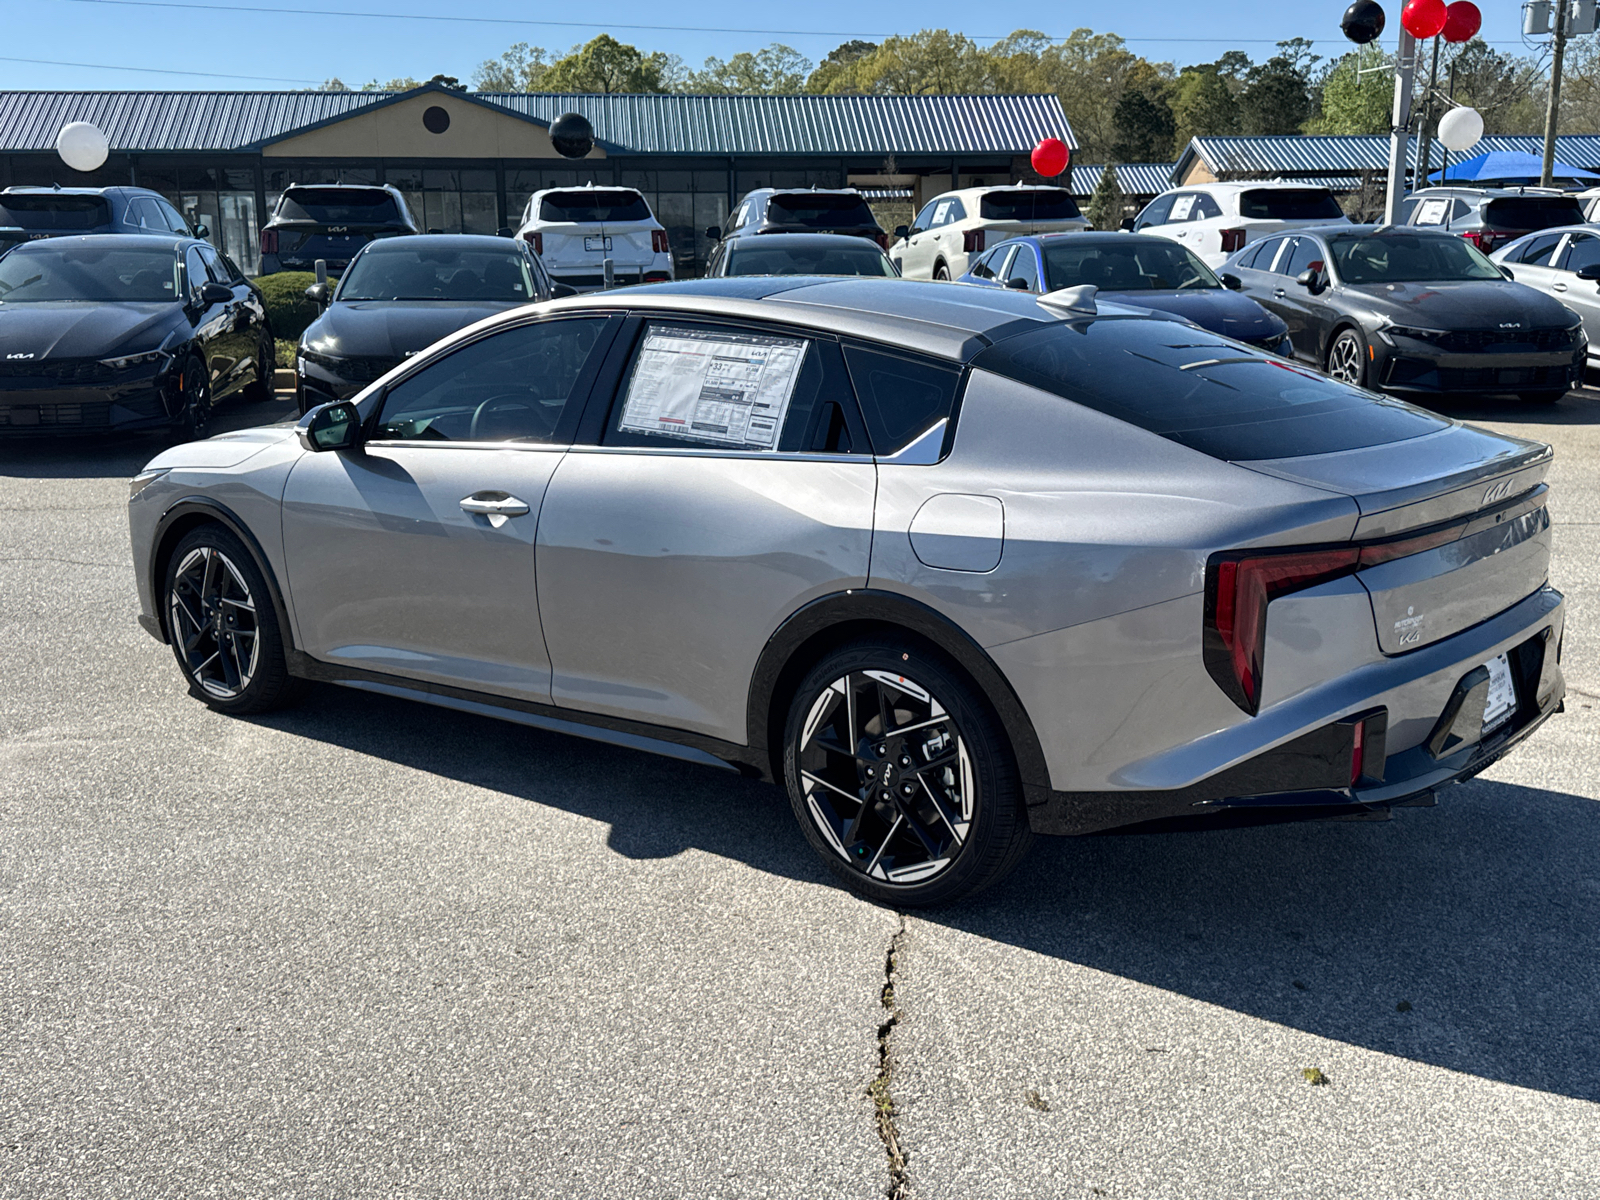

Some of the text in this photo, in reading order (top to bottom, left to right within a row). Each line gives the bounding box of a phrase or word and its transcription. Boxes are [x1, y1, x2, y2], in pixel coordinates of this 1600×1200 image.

[712, 362, 722, 371] 33
[1481, 478, 1514, 505] KIA
[1398, 630, 1420, 646] K4
